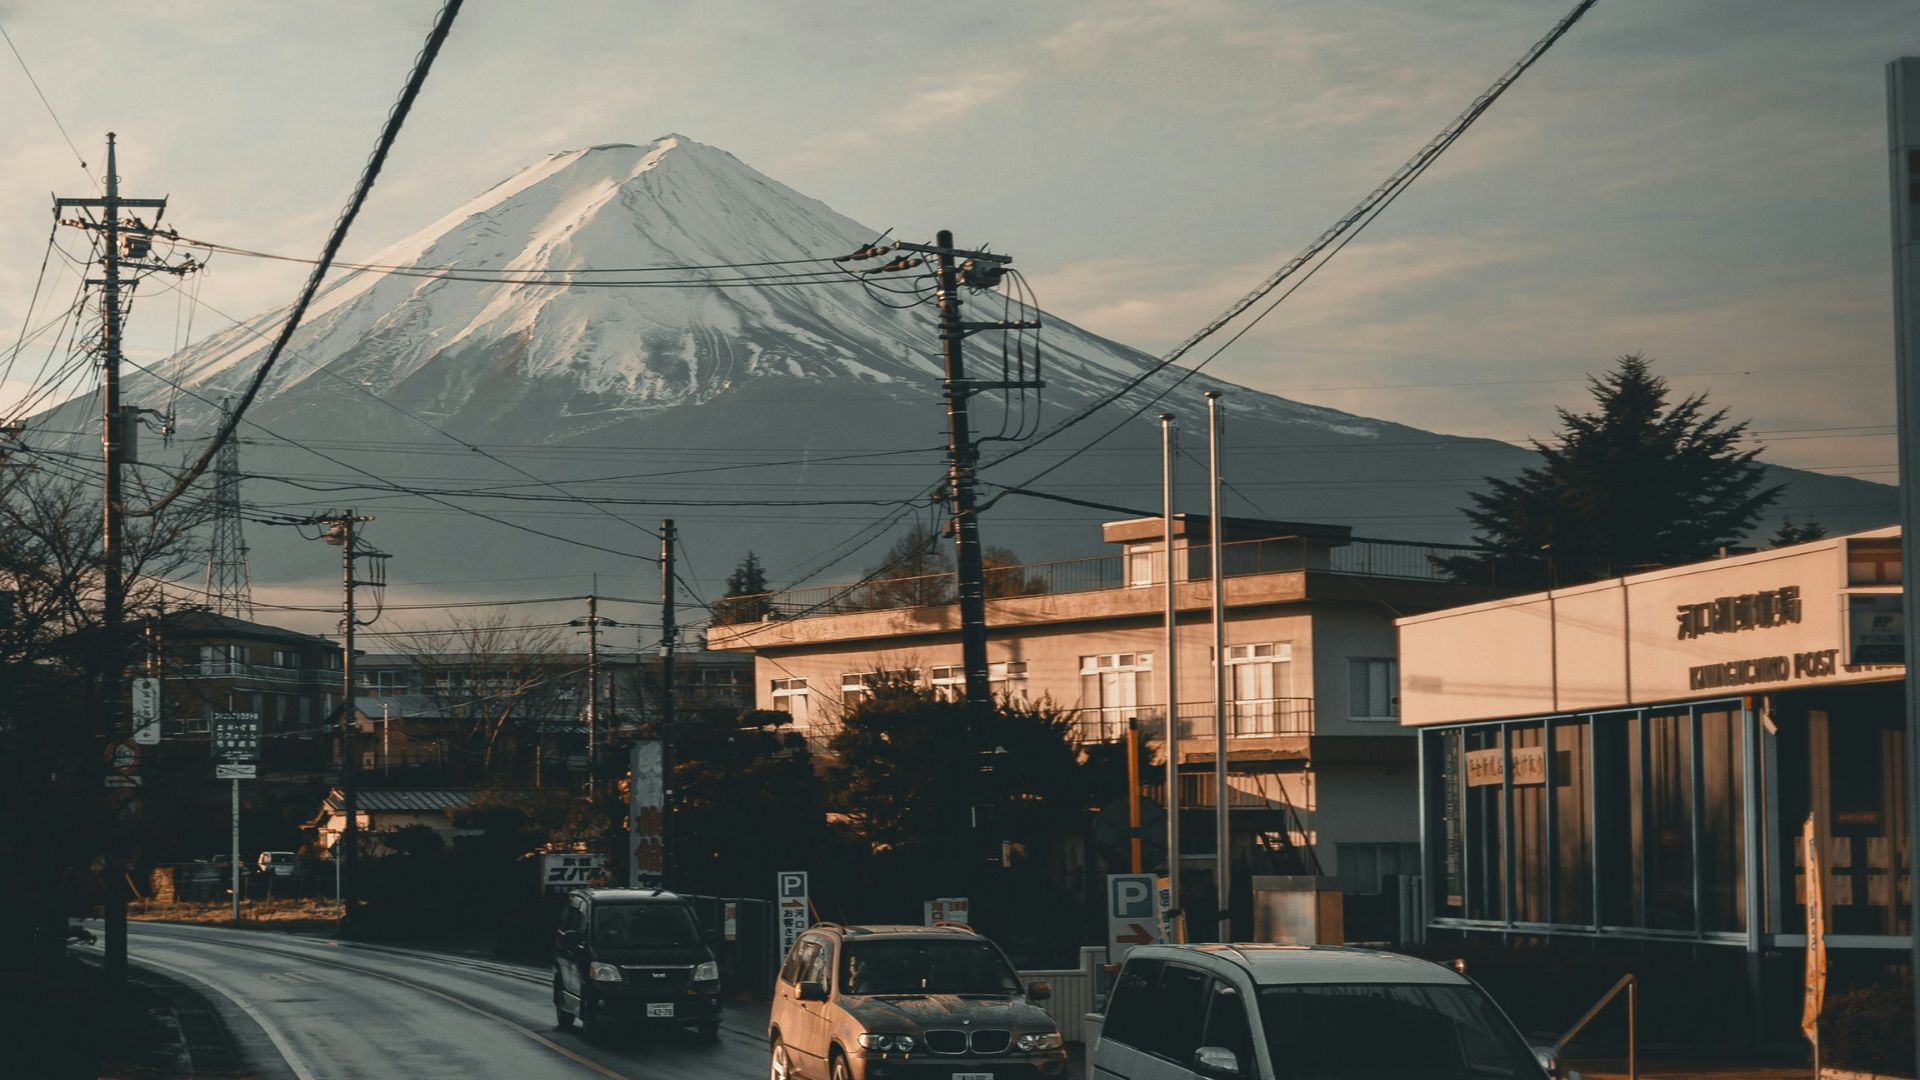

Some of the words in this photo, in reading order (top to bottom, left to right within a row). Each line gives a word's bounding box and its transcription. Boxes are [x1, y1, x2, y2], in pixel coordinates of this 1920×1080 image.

[1795, 649, 1839, 679] POST
[783, 875, 802, 896] P
[1117, 881, 1148, 915] P
[795, 908, 805, 936] 河口
